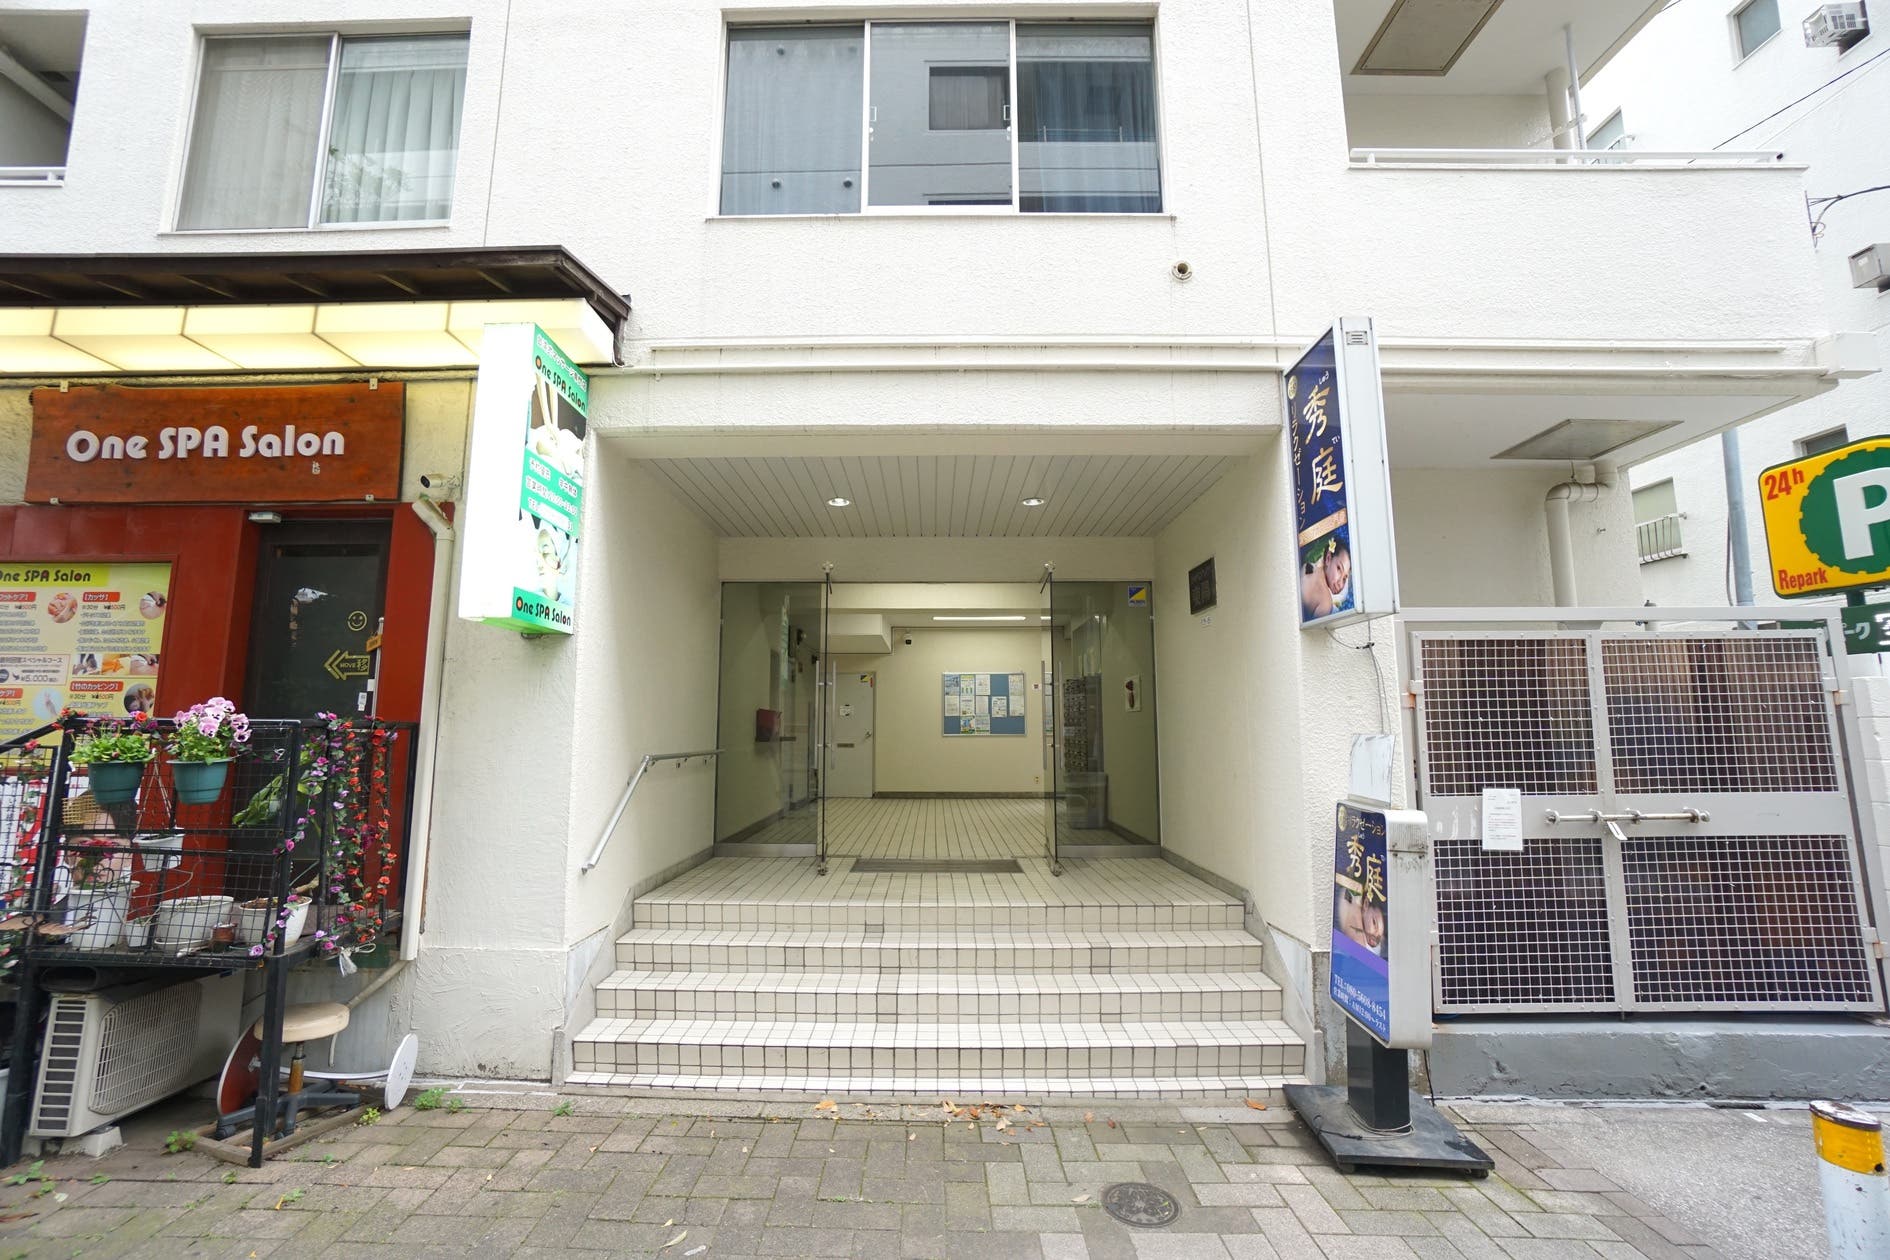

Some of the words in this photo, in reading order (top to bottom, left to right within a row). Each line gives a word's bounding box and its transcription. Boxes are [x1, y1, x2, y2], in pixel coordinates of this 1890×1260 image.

[535, 355, 551, 380] One
[553, 372, 566, 394] SPA
[568, 386, 586, 413] Salon
[66, 430, 148, 463] One
[158, 425, 229, 460] SPA
[239, 424, 346, 459] Salon
[1833, 466, 1890, 560] P
[24, 570, 49, 582] SPA
[53, 569, 91, 582] Salon
[1778, 567, 1828, 591] Repark
[516, 596, 533, 615] One
[535, 602, 550, 620] SPA
[552, 607, 571, 626] Salon
[1842, 622, 1870, 640] ーク
